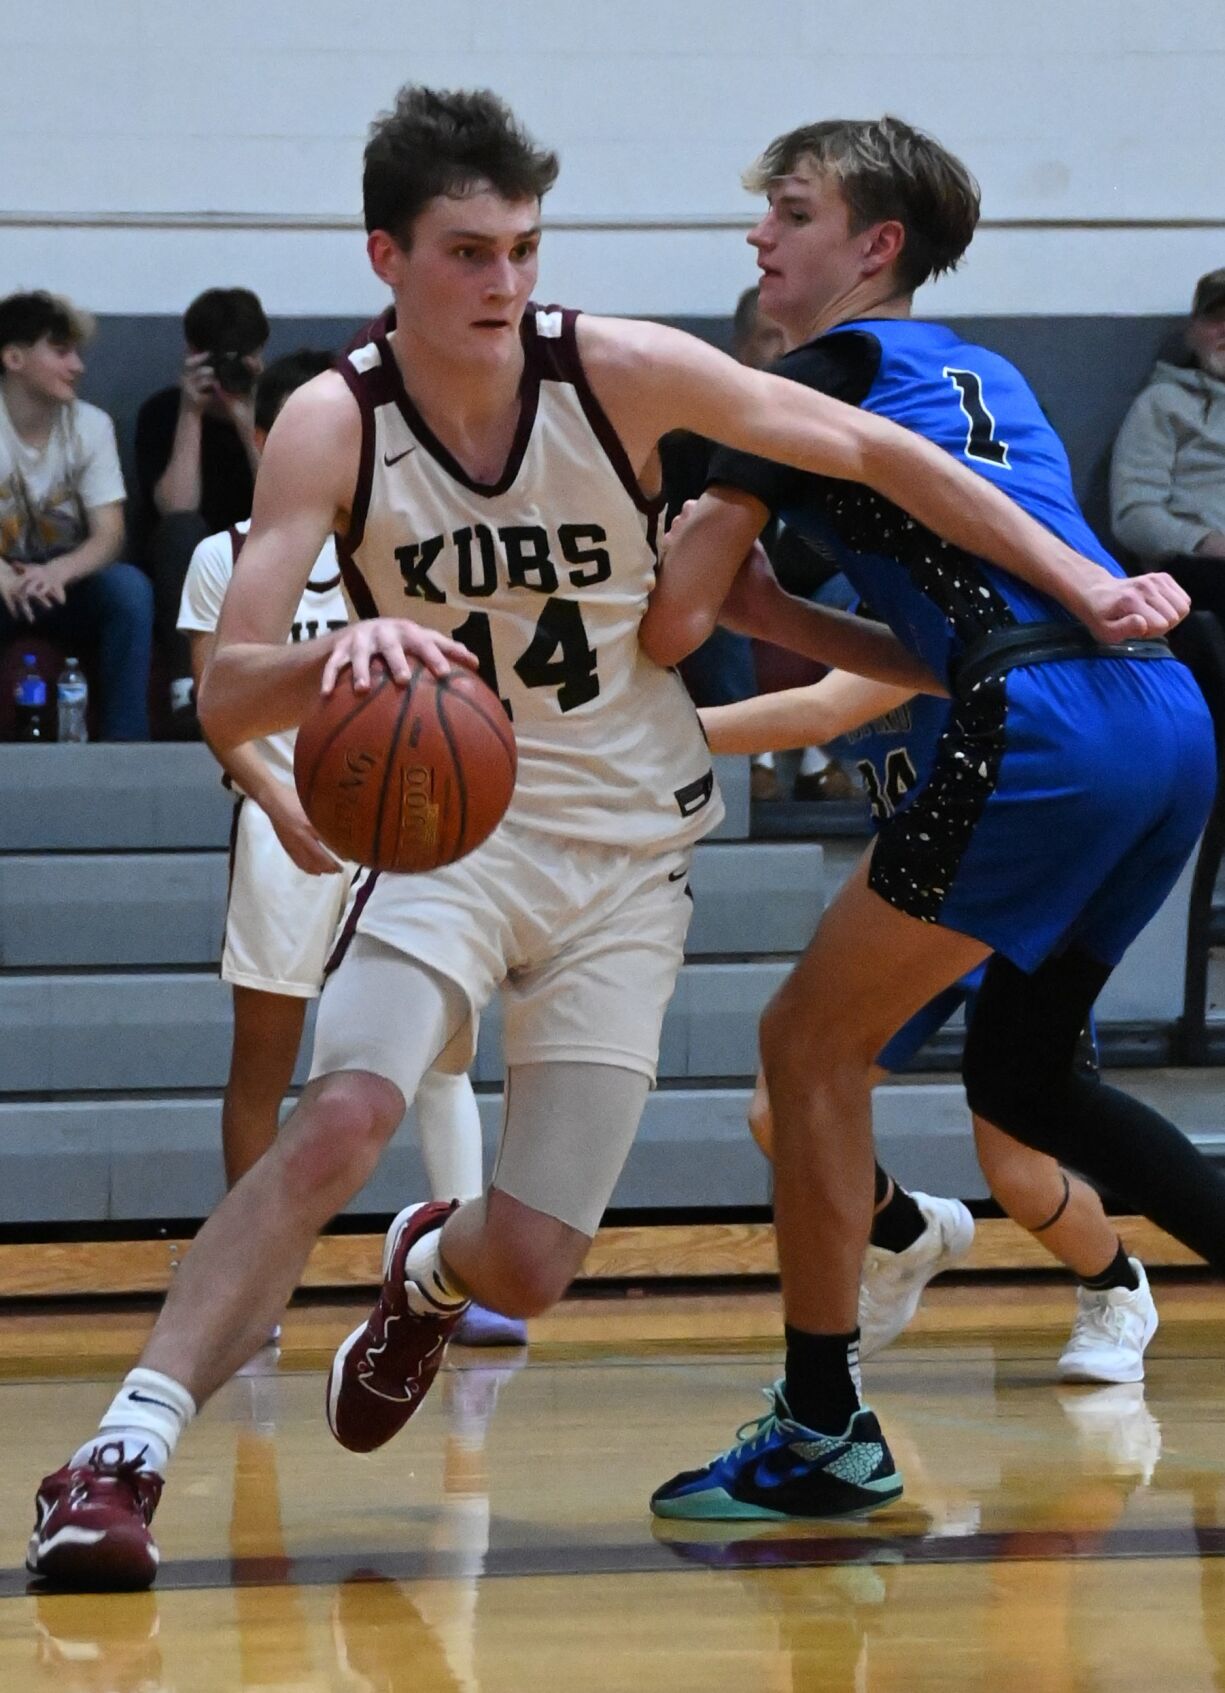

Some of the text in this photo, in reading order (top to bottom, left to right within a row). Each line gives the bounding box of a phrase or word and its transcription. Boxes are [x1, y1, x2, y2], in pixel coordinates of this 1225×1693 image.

[943, 366, 1012, 470] 1
[394, 523, 612, 604] KUBS
[451, 597, 600, 723] 14
